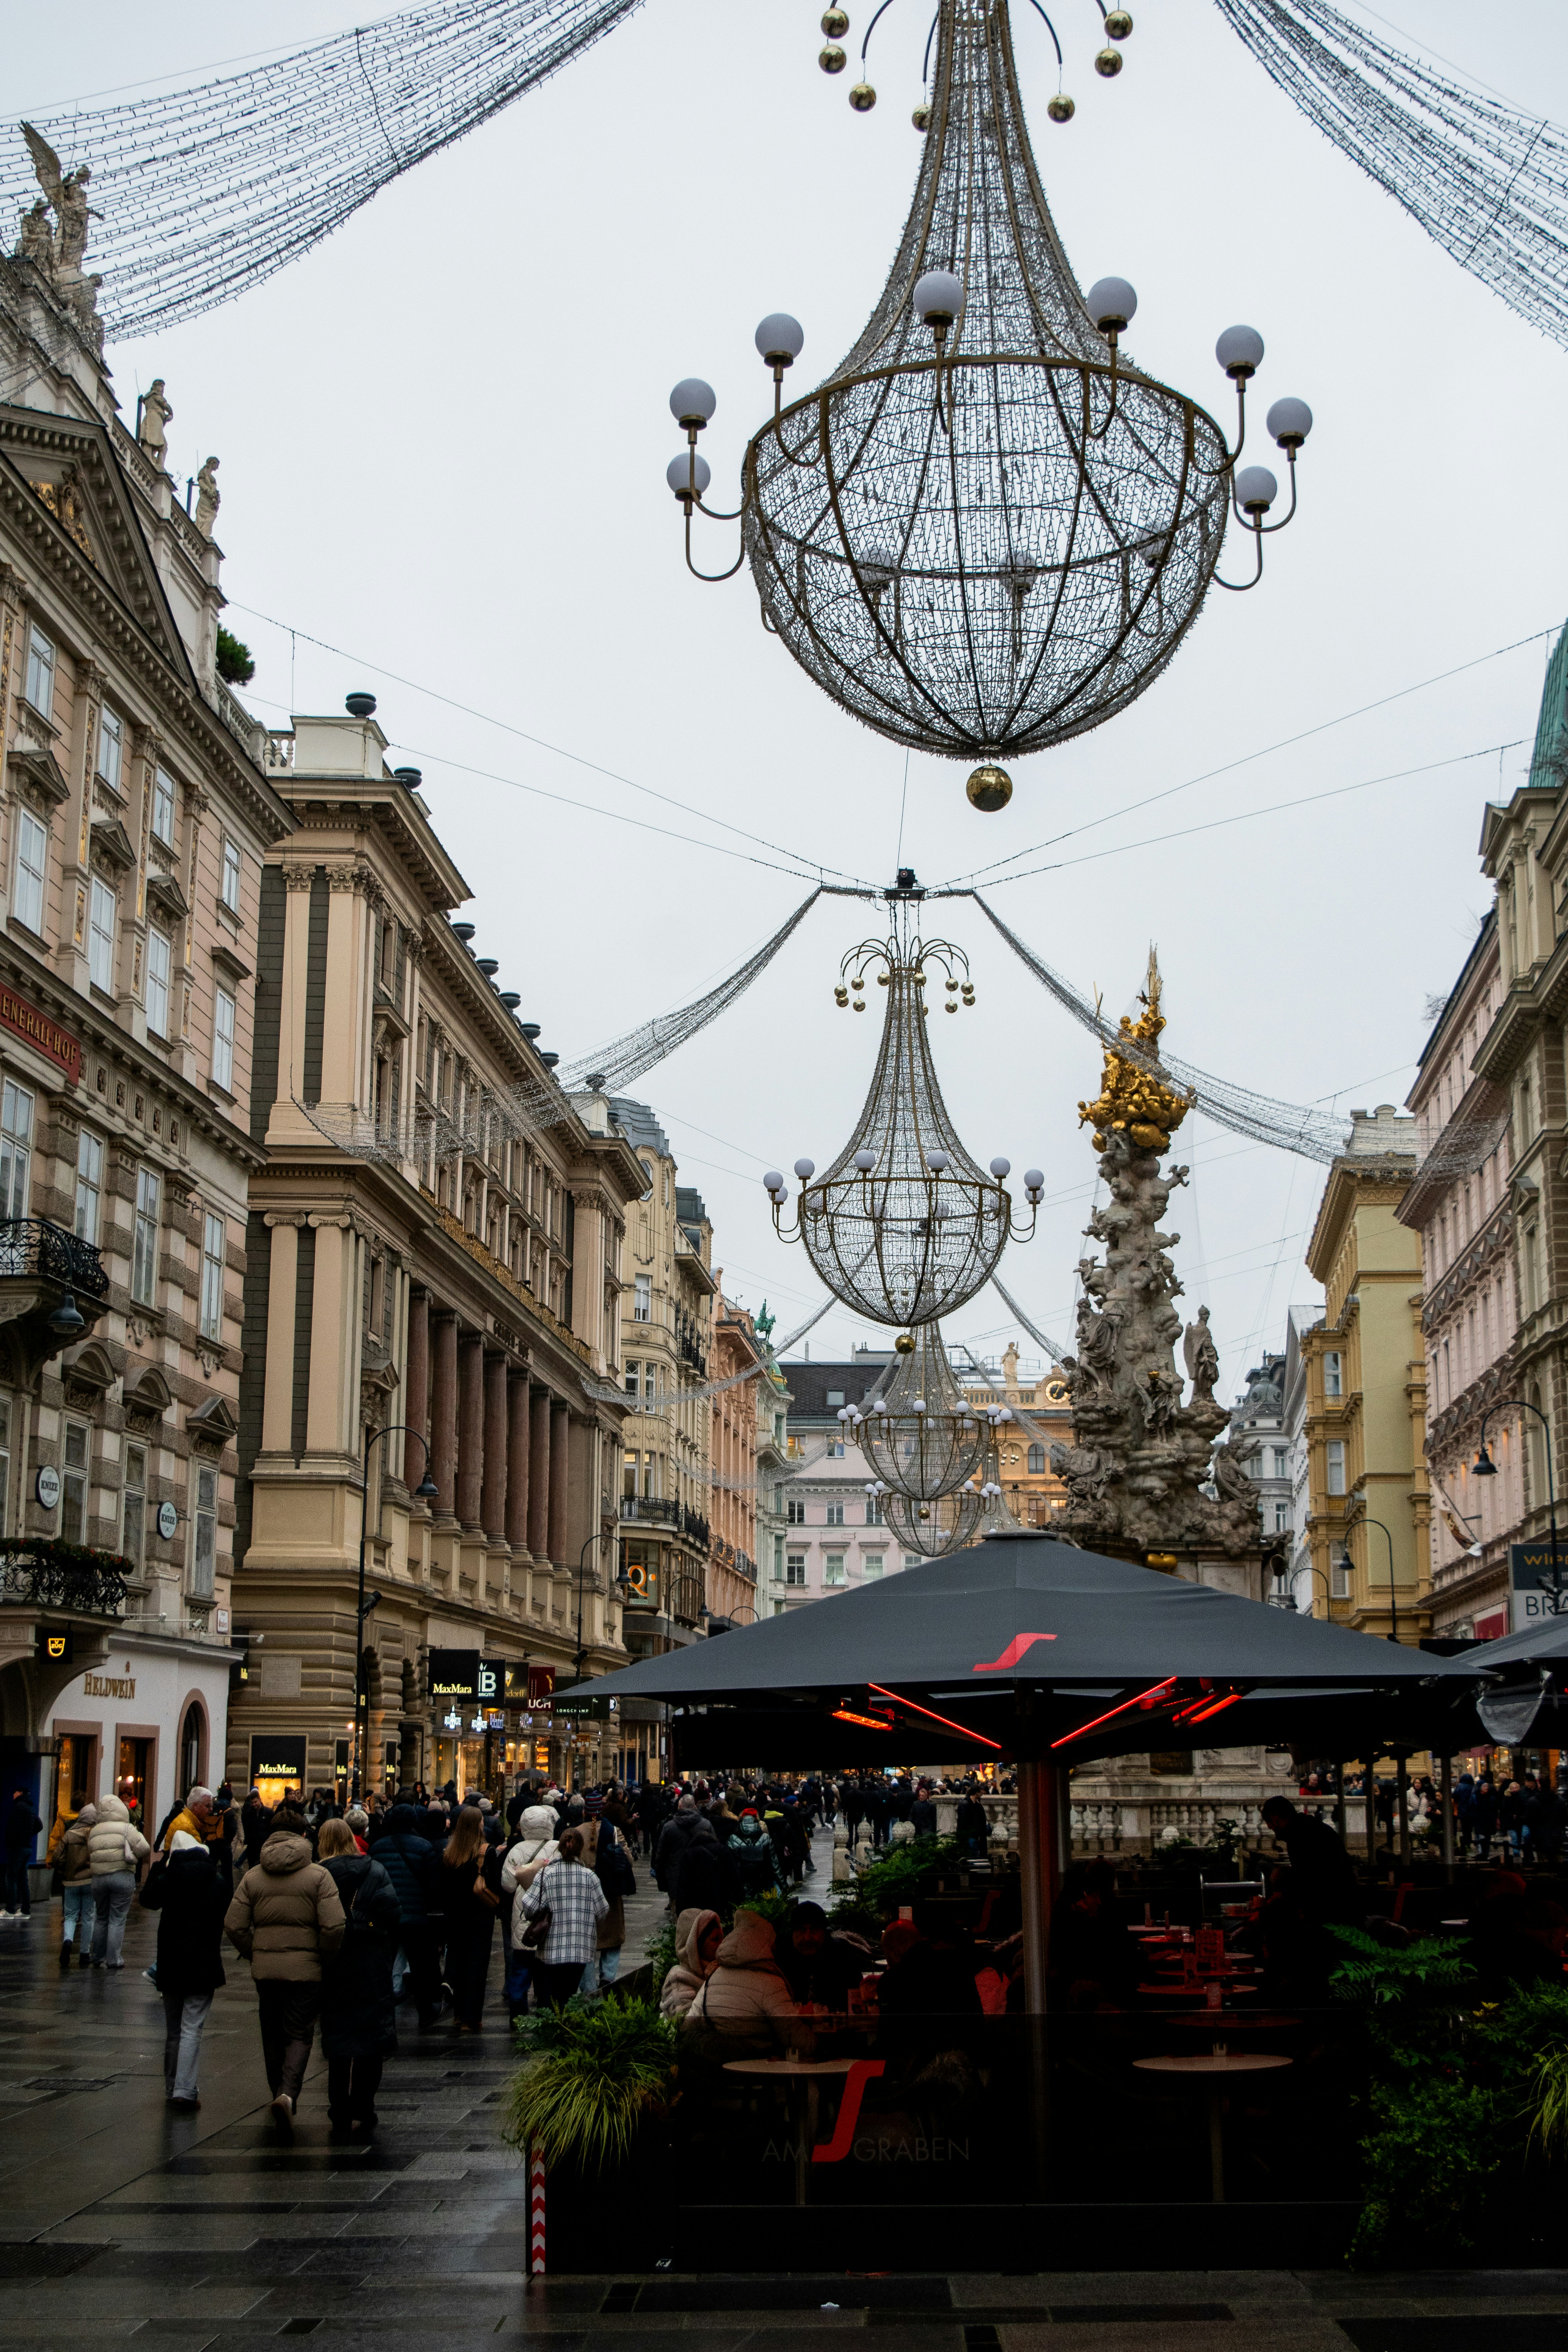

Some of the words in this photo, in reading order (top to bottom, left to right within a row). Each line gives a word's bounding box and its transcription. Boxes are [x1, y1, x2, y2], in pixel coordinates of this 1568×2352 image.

[41, 1480, 58, 1492] KNIZE
[161, 1514, 175, 1525] KNIZE
[83, 1673, 136, 1699] HELDWEIN
[433, 1683, 472, 1693] MaxMara
[528, 1699, 551, 1708] UCH
[259, 1764, 297, 1774] MaxMara
[762, 2138, 808, 2162] AM
[853, 2136, 969, 2163] GRABEN
